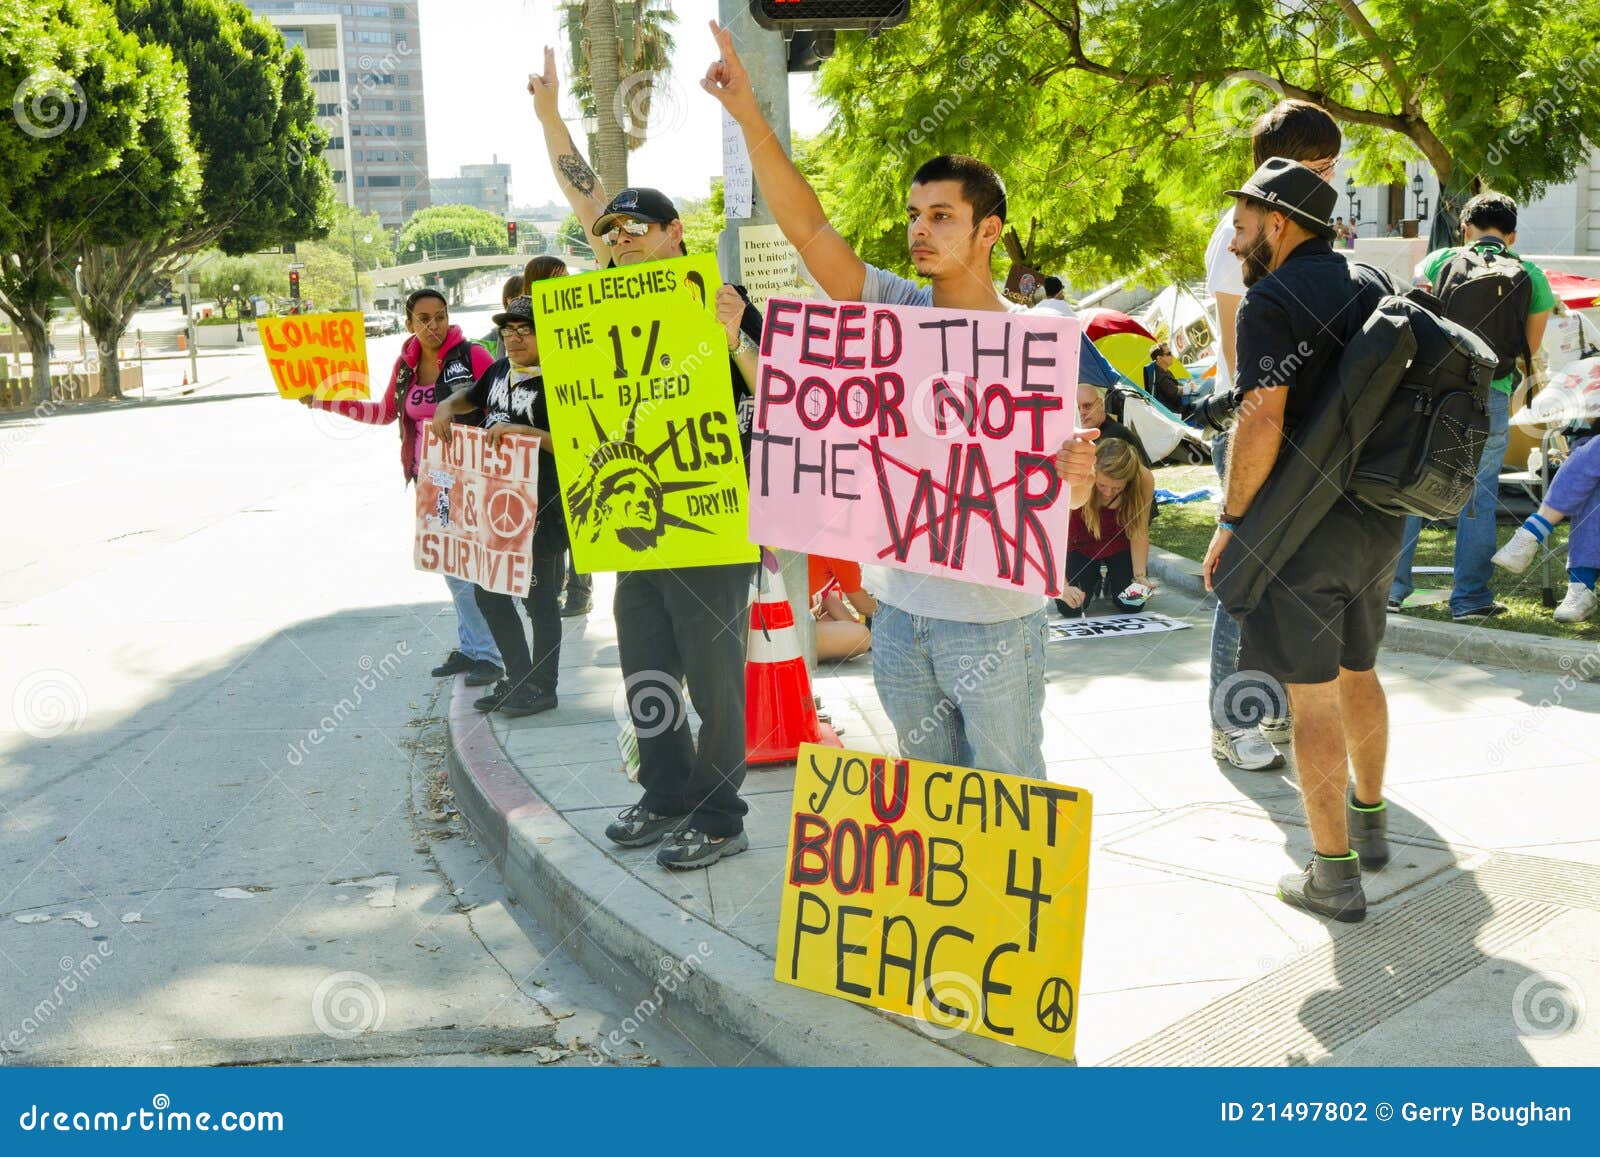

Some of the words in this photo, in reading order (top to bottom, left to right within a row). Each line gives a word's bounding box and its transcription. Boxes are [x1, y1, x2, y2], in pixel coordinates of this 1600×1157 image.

[745, 240, 771, 250] There
[758, 251, 788, 263] United
[542, 286, 585, 316] LIKE
[755, 280, 781, 291] today
[265, 319, 356, 354] LOWER
[554, 322, 594, 350] THE
[607, 320, 672, 379] 1%
[761, 298, 903, 369] FEED
[918, 318, 1058, 392] THE
[269, 356, 366, 395] TUITION
[554, 378, 604, 406] WILL
[617, 374, 690, 407] BLEED
[758, 365, 908, 438] POOR
[931, 376, 1063, 451] NOT
[422, 425, 537, 479] PROTEST
[686, 487, 740, 517] DRY!!!
[751, 429, 861, 500] THE
[869, 435, 1063, 597] WAR
[420, 533, 526, 594] SURVIVE
[924, 771, 1078, 848] CANT
[1004, 848, 1052, 952] 4
[791, 890, 1021, 1036] PEACE
